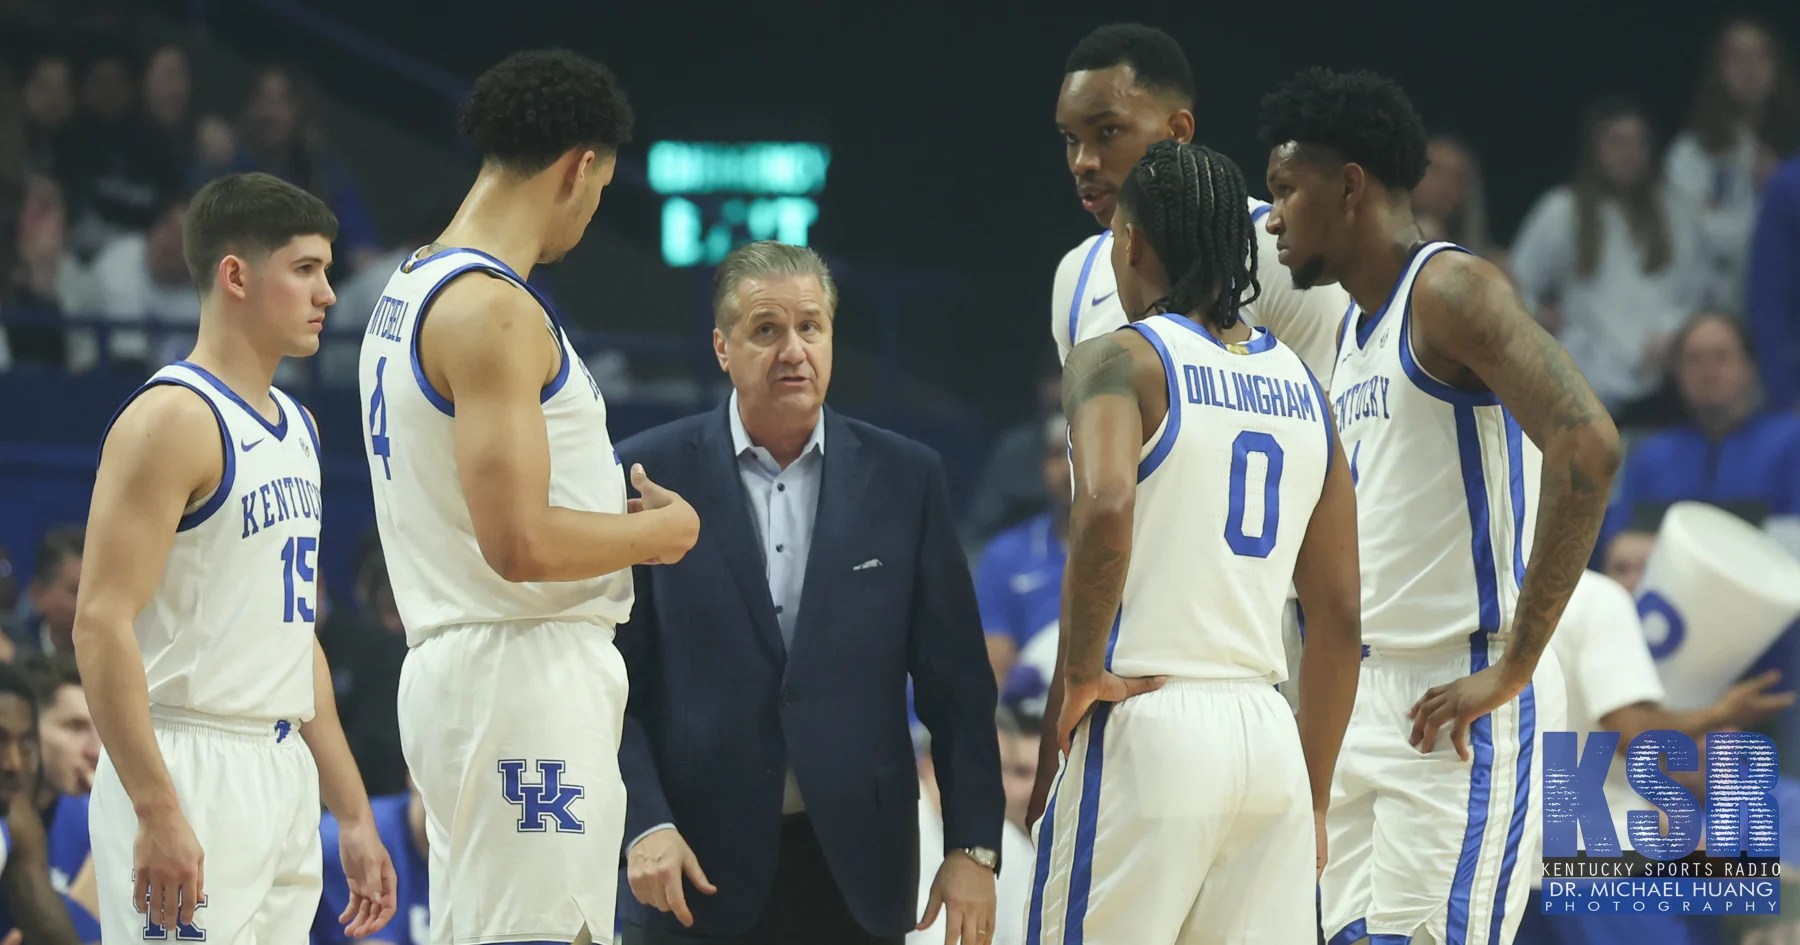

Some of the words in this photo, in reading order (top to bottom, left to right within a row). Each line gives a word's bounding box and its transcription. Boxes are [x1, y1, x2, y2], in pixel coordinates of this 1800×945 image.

[369, 356, 391, 480] 4
[1183, 364, 1317, 423] DILLINGHAM
[1332, 375, 1390, 433] ENTUCKY
[241, 476, 321, 540] KENTUCK
[1224, 430, 1284, 559] 0
[280, 536, 317, 623] 15
[498, 759, 585, 834] UK
